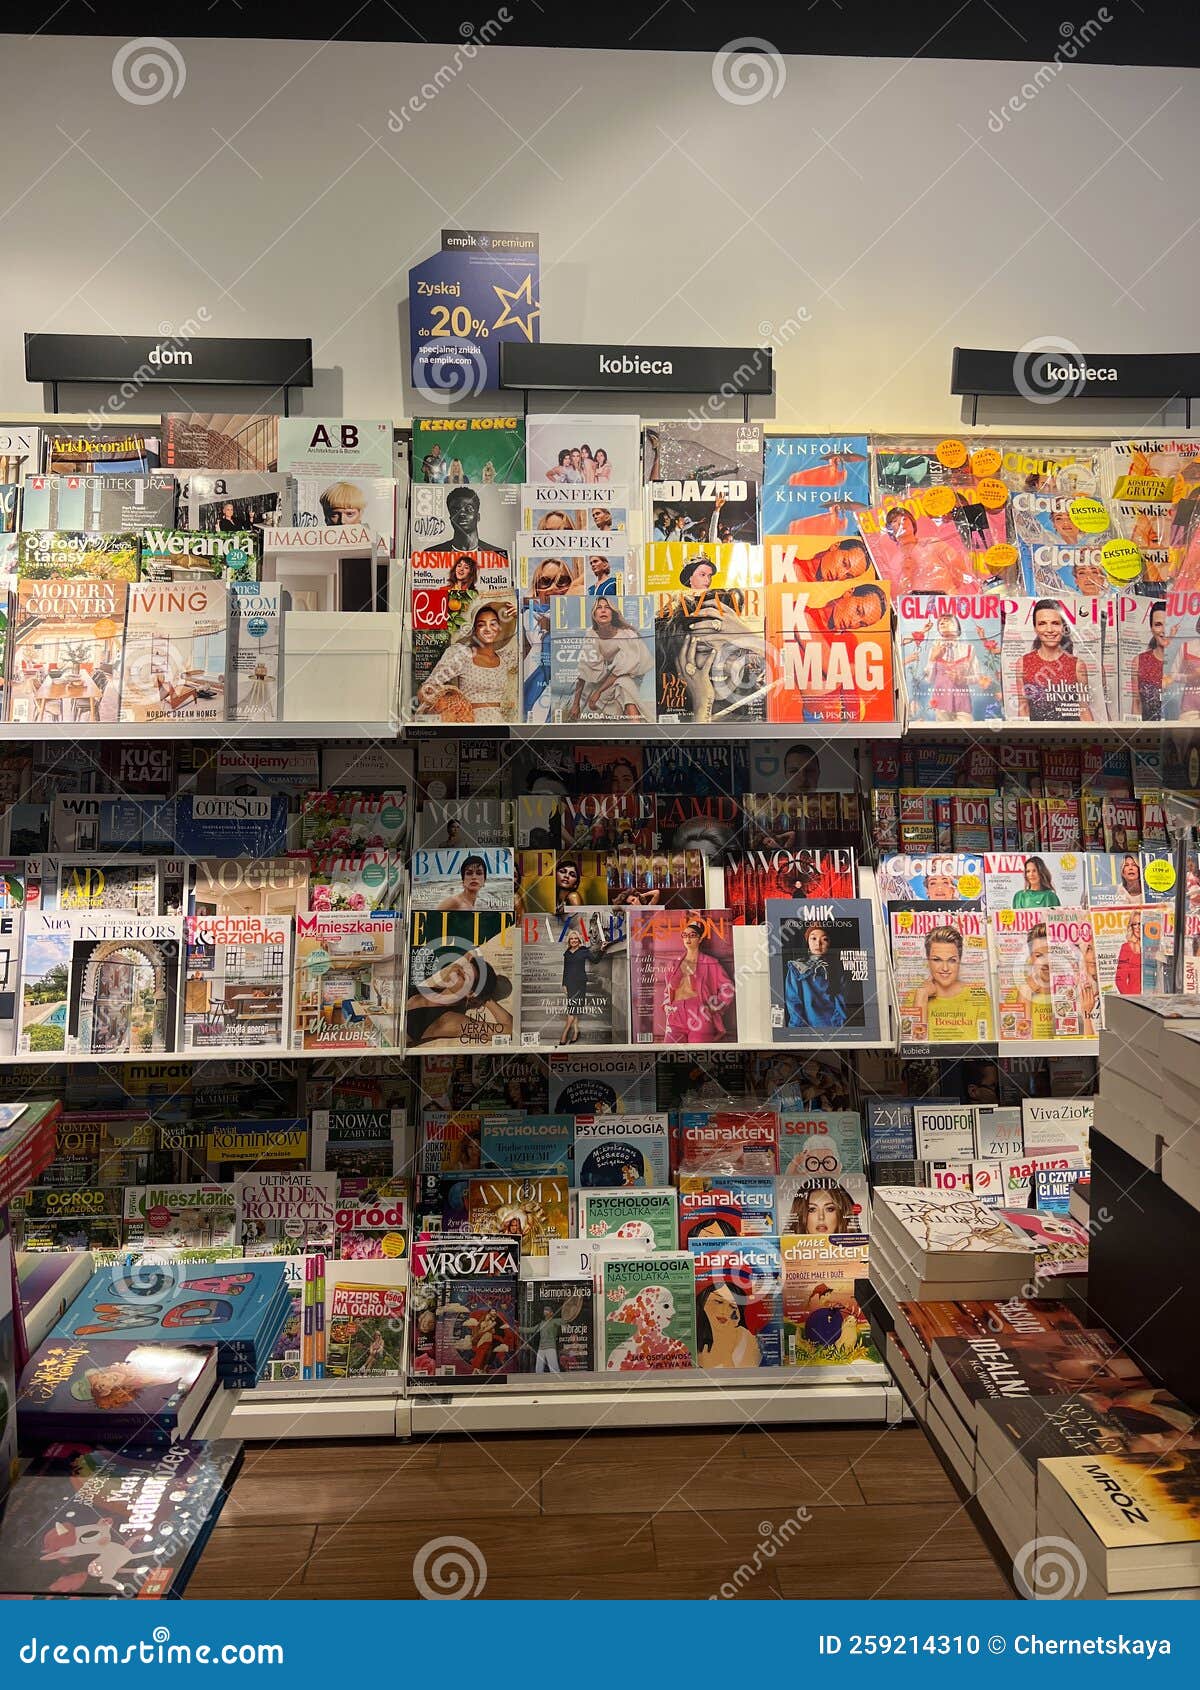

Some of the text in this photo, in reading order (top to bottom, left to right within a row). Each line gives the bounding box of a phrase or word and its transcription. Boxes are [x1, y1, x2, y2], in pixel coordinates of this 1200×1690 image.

[447, 235, 534, 248] empik premium
[417, 282, 461, 297] Zyskaj
[418, 305, 489, 337] do 20%
[148, 345, 193, 365] dom
[430, 356, 472, 367] empik.com
[598, 355, 673, 375] kobieca
[1046, 362, 1118, 382] kobieca
[420, 417, 518, 431] KING KONG
[777, 443, 854, 456] KINFOLK
[537, 489, 615, 501] KONFEKT
[666, 480, 747, 501] DAZED
[776, 491, 854, 502] KINFOLK
[1127, 487, 1165, 497] GRATIS
[145, 530, 254, 556] Weranda
[268, 527, 371, 546] IMAGICASA
[532, 536, 613, 548] KONFEKT
[25, 537, 88, 554] Ogrody
[412, 550, 510, 569] COSMOLITAN
[480, 575, 508, 584] Natalia
[32, 583, 116, 599] MODERN
[25, 598, 120, 613] COUNTRY
[413, 591, 449, 628] Red
[901, 595, 999, 620] GLAMOUR
[556, 650, 600, 663] CZAS
[784, 641, 885, 691] MAG
[146, 709, 217, 719] NORDIC DREAM HOMES
[814, 711, 857, 720] LA PISCINE
[462, 749, 489, 759] LIFE
[565, 794, 655, 819] VOGUE
[756, 849, 851, 874] VOGUE
[887, 853, 983, 877] Claudia
[200, 860, 306, 890] VOGUE
[64, 867, 105, 898] AD
[197, 916, 261, 933] kuchnia
[317, 920, 393, 934] mieszkanie
[413, 911, 514, 947] ELLE
[79, 926, 176, 939] INTERIORS
[840, 951, 868, 961] AUTUMN
[843, 961, 868, 971] WINTER
[852, 971, 869, 981] 2022
[469, 1014, 486, 1023] UN
[935, 1018, 973, 1026] Bosacka
[460, 1023, 504, 1034] VERANO
[316, 1031, 377, 1042] JAK LUBISZ
[460, 1034, 489, 1044] CHIC
[903, 1047, 930, 1055] kobieca
[484, 1125, 569, 1137] PSYCHOLOGIA
[576, 1124, 662, 1136] PSYCHOLOGIA
[686, 1126, 774, 1142] charaktery
[785, 1120, 829, 1135] sens
[1009, 1159, 1069, 1178] natura
[259, 1175, 312, 1185] ULTIMATE
[1049, 1171, 1077, 1182] CZYM
[46, 1188, 105, 1204] OGRÓD
[243, 1186, 328, 1202] GARDEN
[1038, 1183, 1069, 1195] CI NIE
[151, 1189, 235, 1207] Mieszkanie
[589, 1197, 670, 1208] PSYCHOLOGIA
[682, 1191, 774, 1208] charaktery
[589, 1207, 650, 1217] NASTOLATKA
[784, 1244, 869, 1262] charaktery
[607, 1261, 690, 1273] PSYCHOLOGIA
[607, 1273, 670, 1282] NASTOLATKA
[333, 1304, 348, 1315] NA
[1081, 1463, 1150, 1525] MRÓZ
